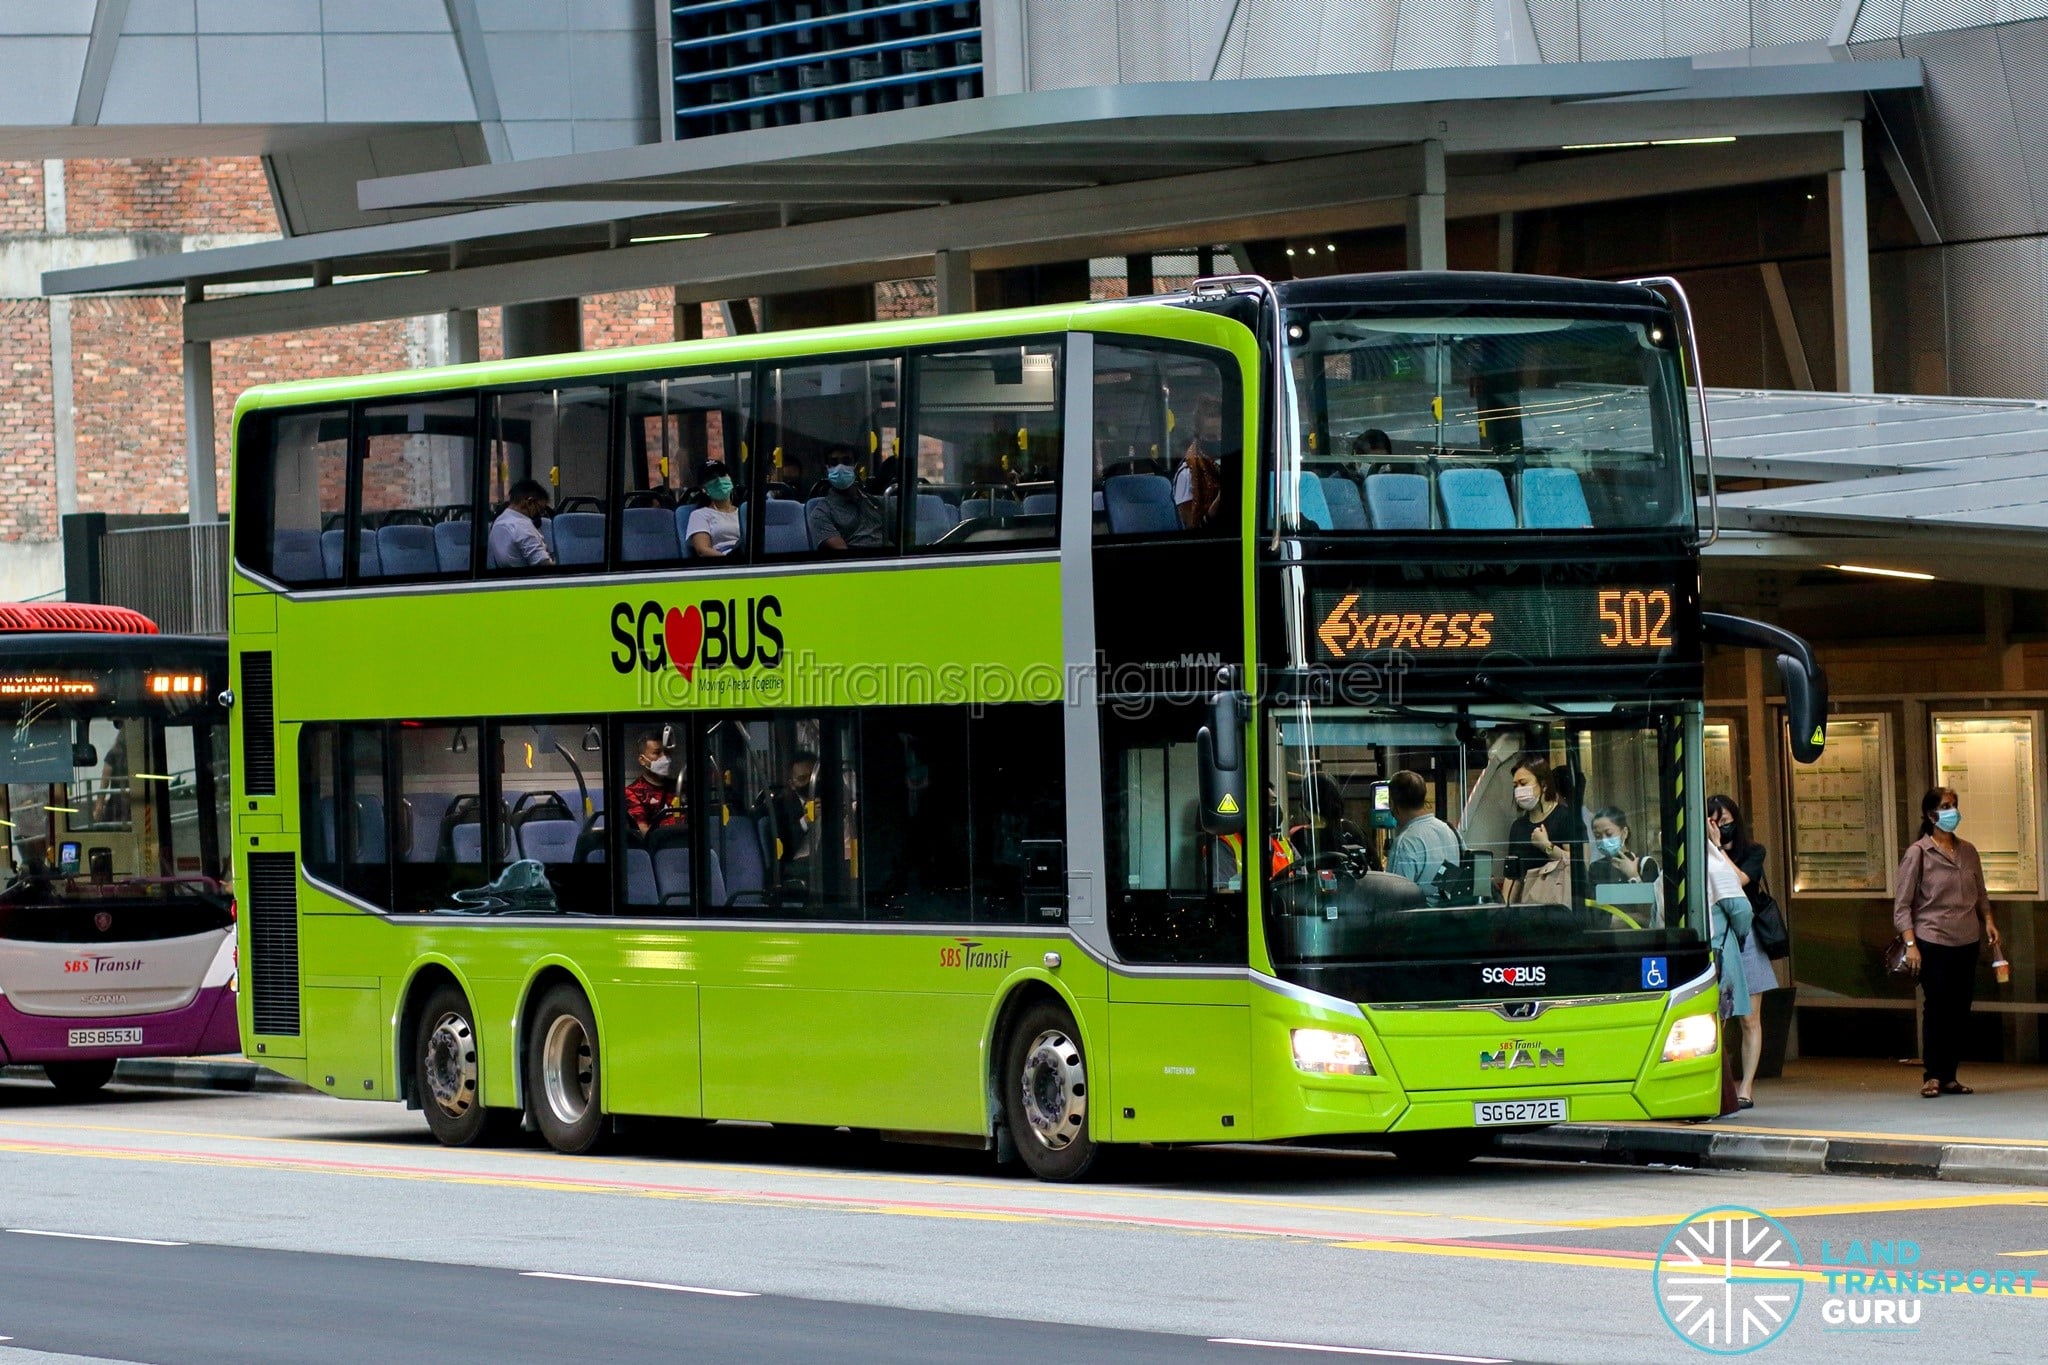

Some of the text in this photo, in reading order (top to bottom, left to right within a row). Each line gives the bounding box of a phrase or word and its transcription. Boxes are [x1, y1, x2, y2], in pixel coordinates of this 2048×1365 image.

[1599, 590, 1672, 647] 502
[1180, 652, 1221, 668] MAN
[699, 676, 784, 694] Moving Ahead Together
[64, 956, 146, 974] SBS Transit
[940, 942, 1012, 972] SBS Transit
[70, 1031, 142, 1044] SBS8553U
[1500, 1039, 1542, 1050] SBS Transit
[1479, 1048, 1565, 1069] MAN
[1481, 1102, 1560, 1121] SG6272E
